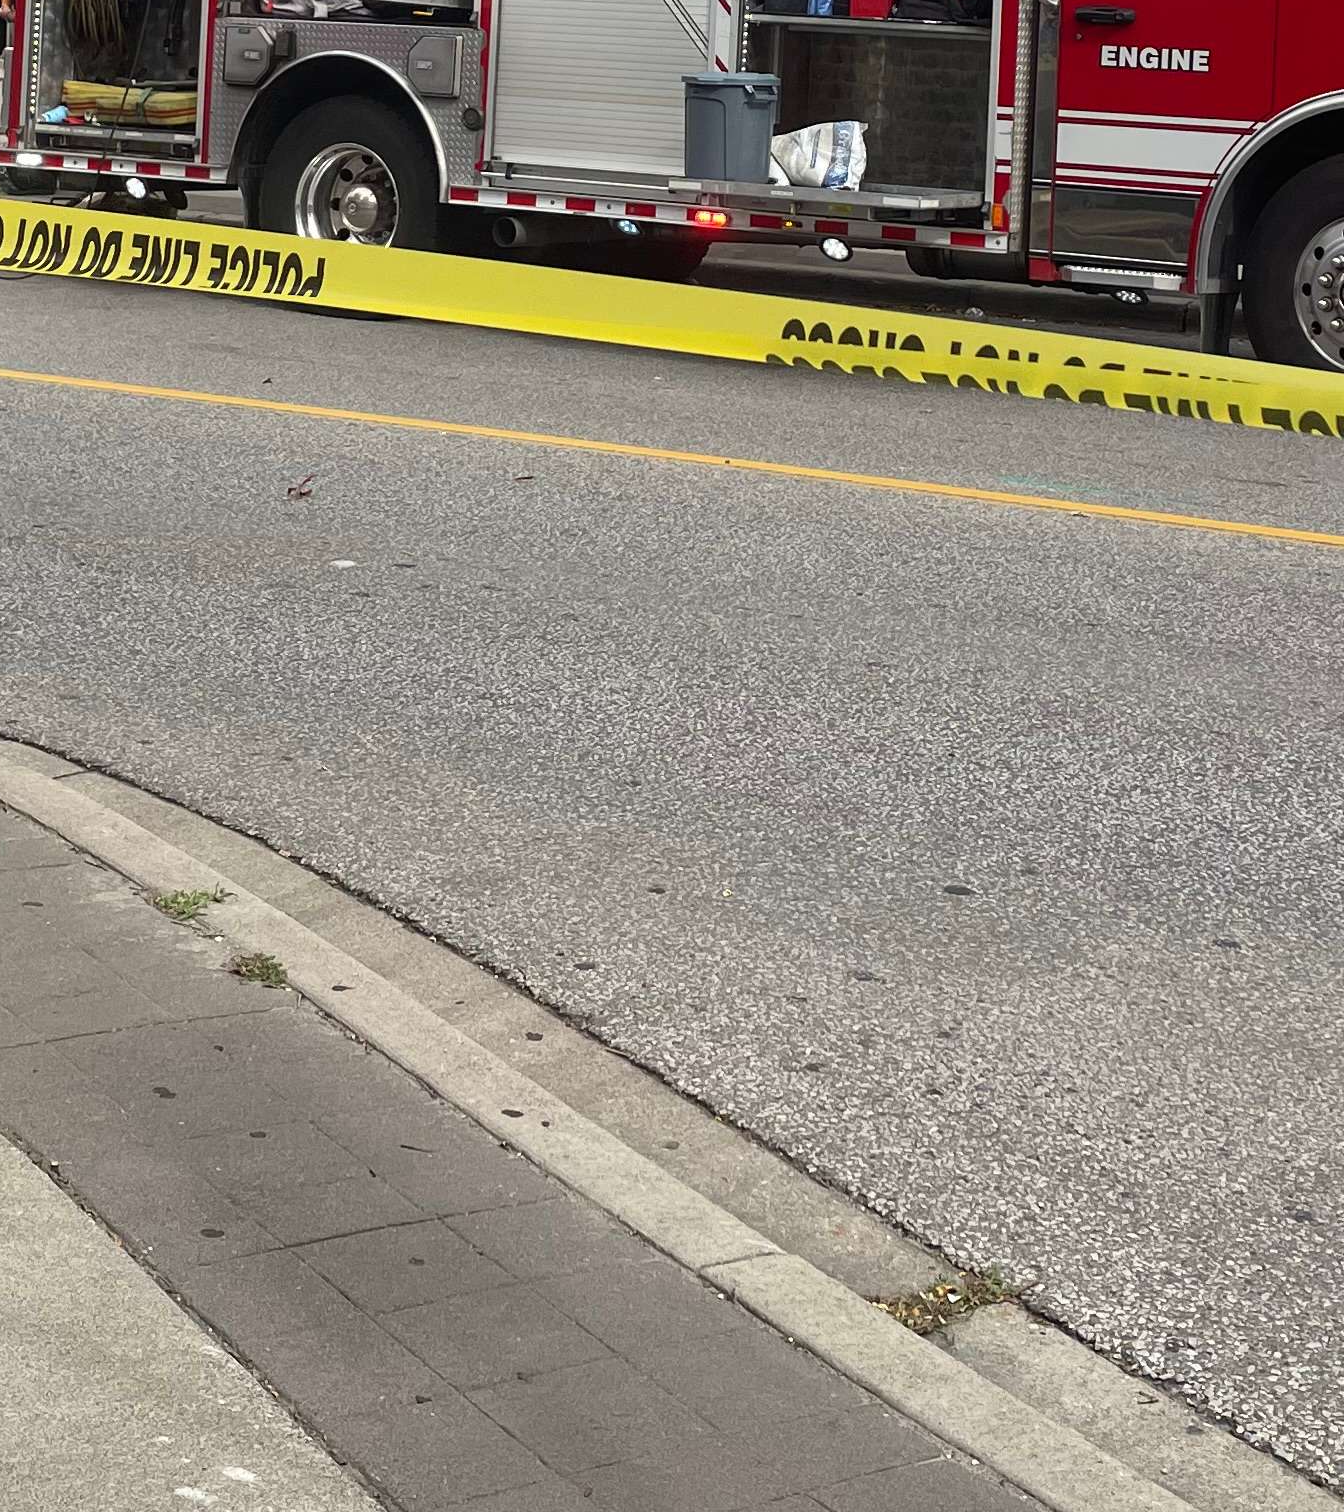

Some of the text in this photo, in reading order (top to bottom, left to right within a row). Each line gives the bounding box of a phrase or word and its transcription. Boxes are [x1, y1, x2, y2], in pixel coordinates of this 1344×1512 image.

[1100, 44, 1211, 72] ENGINE
[68, 225, 124, 280] DO
[117, 233, 201, 287] LINE
[207, 242, 326, 299] POLICE
